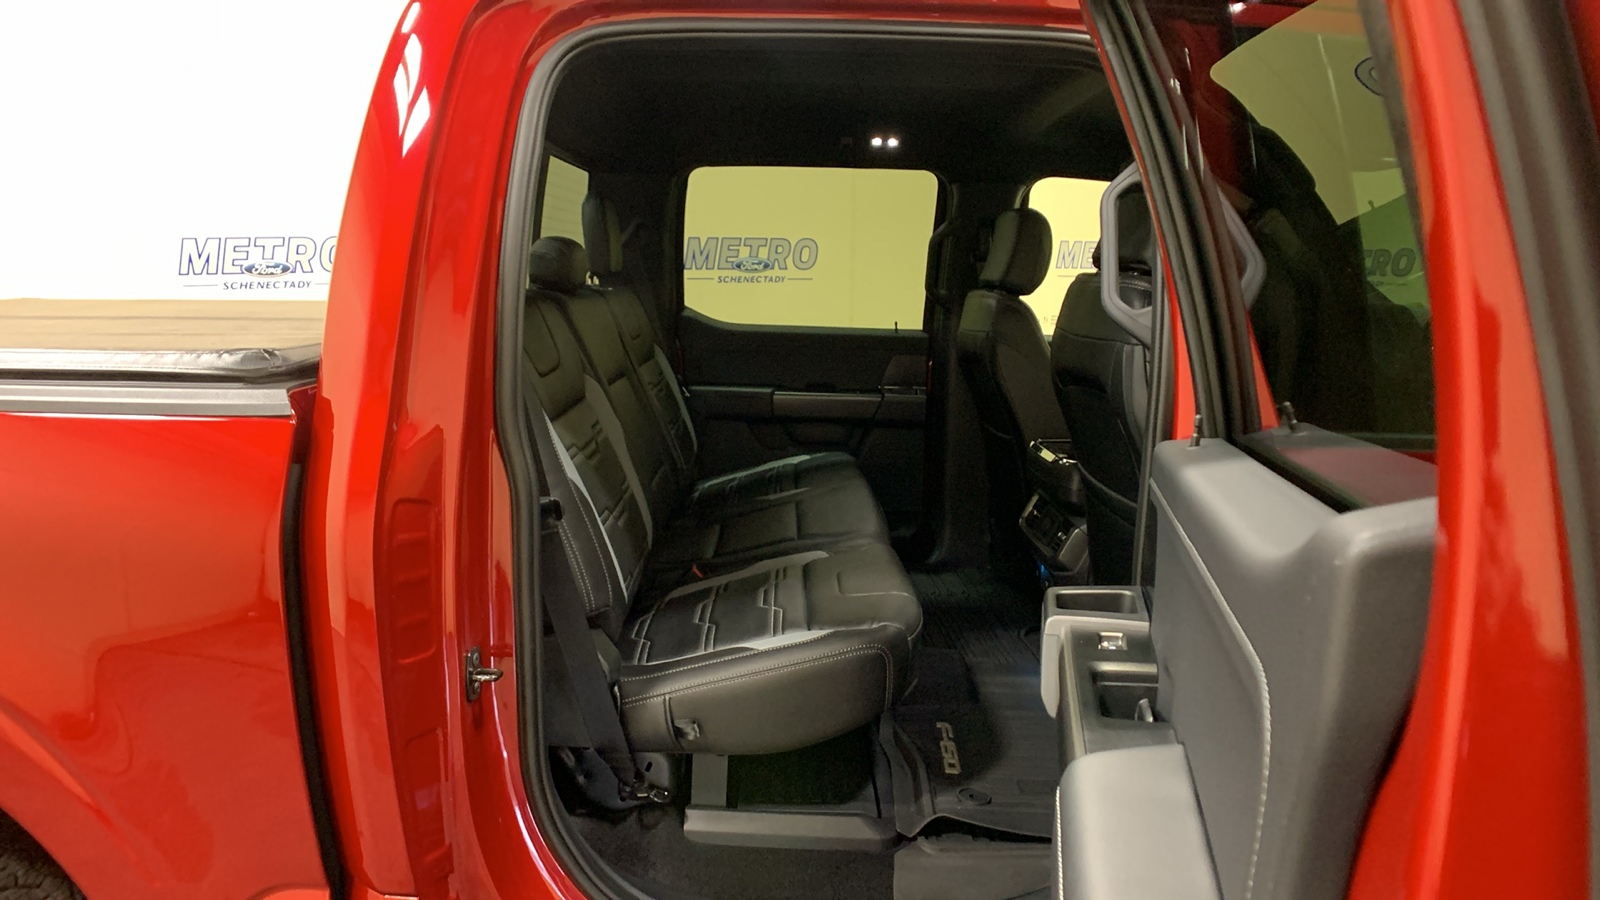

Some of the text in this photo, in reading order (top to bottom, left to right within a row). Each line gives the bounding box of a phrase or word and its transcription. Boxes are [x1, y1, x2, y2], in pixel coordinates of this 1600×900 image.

[683, 237, 819, 271] METRO
[250, 262, 284, 276] Ford
[223, 280, 312, 290] SCHENECTADY
[717, 275, 787, 284] SCHENECTADY
